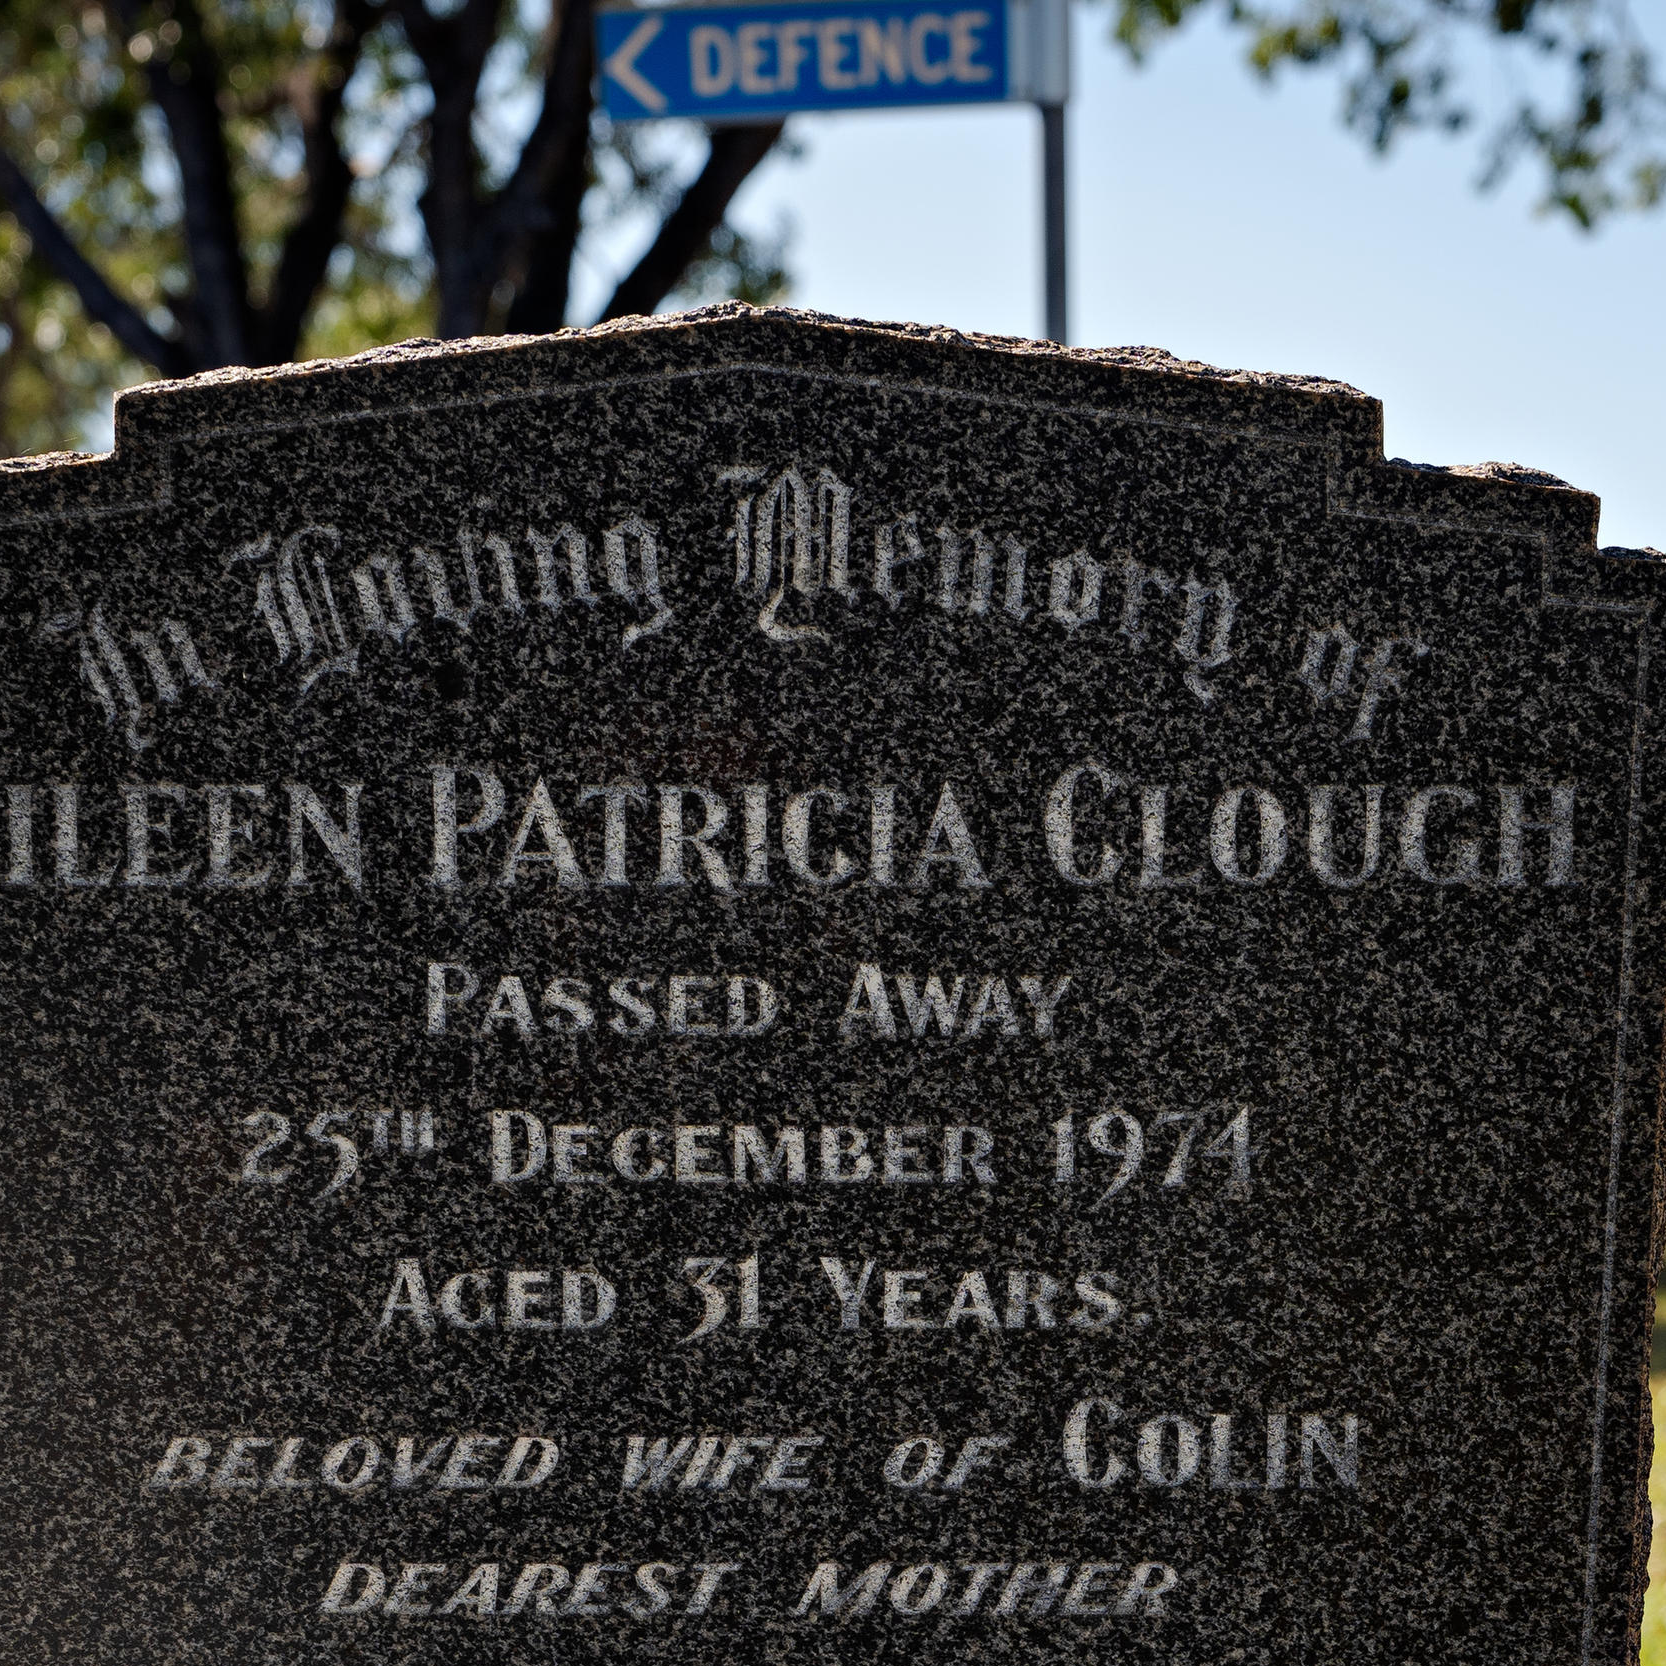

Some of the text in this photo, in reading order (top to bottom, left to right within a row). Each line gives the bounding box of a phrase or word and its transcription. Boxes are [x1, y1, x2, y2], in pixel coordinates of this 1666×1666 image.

[688, 10, 992, 97] DEFENCE
[718, 462, 1238, 708] Memory
[431, 762, 995, 890] PATRICIA
[1043, 762, 1578, 890] CLOUGH
[421, 960, 1073, 1038] PASSED AWAY
[488, 1108, 998, 1185] DECEMBER
[1051, 1104, 1258, 1210] 1974
[376, 1256, 618, 1332] AGED
[678, 1254, 761, 1345] 31
[148, 1398, 1363, 1494] BELOVED WIFE OF COLIN
[321, 1560, 1181, 1618] DEAREST MOTHER
